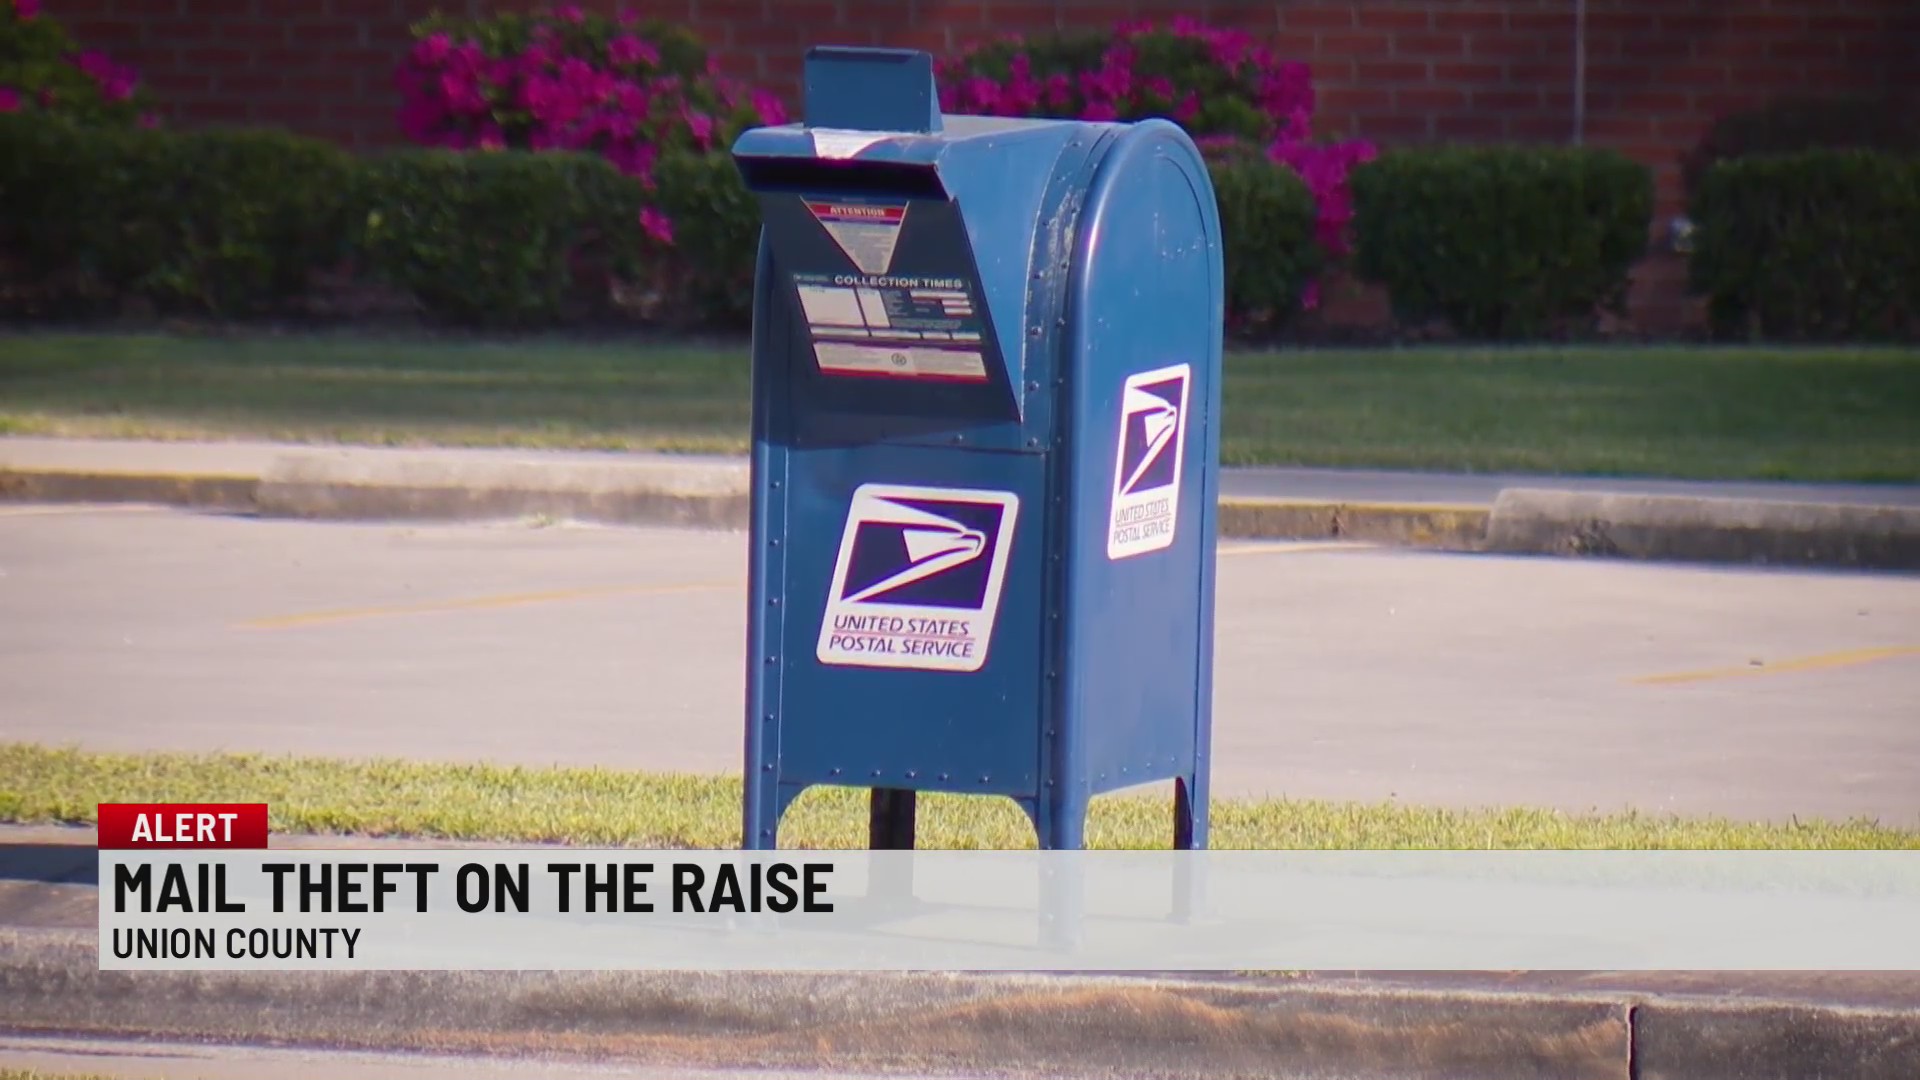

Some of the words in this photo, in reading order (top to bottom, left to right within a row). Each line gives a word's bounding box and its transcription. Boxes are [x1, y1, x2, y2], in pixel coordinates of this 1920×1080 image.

[830, 206, 885, 217] ATTENTION
[834, 275, 918, 288] COLLECTION
[923, 278, 963, 289] TIMES
[1115, 504, 1144, 523] UNITED
[1145, 498, 1169, 516] STATES
[1113, 525, 1140, 544] POSTAL
[1142, 518, 1171, 539] SERVICE
[834, 614, 903, 632] UNITED
[906, 618, 970, 635] STATES
[829, 635, 896, 653] POSTAL
[900, 639, 975, 658] SERVICE
